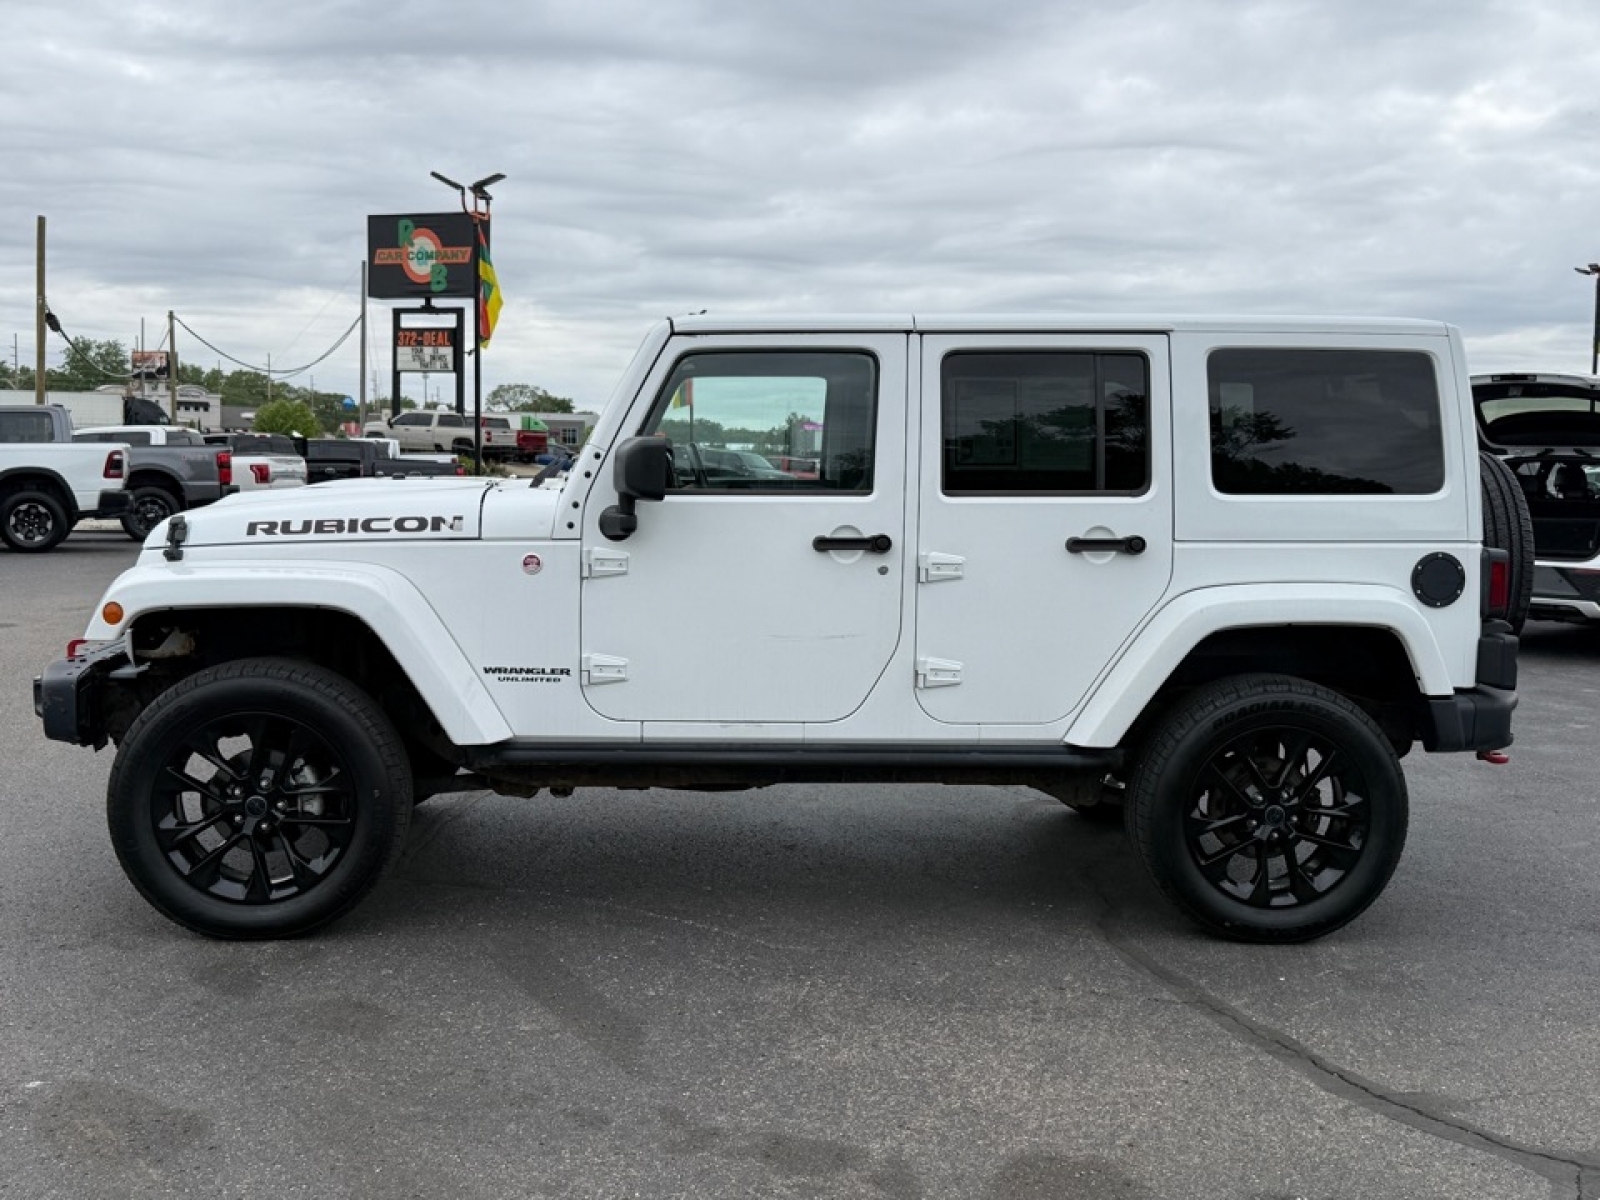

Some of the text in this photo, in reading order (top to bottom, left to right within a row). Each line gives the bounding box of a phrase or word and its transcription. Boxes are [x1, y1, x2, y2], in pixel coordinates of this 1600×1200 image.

[377, 250, 468, 262] CAR COMPANY
[246, 515, 464, 535] RUBICON
[483, 666, 571, 676] WRANGLER
[498, 676, 560, 684] UNLIMITED
